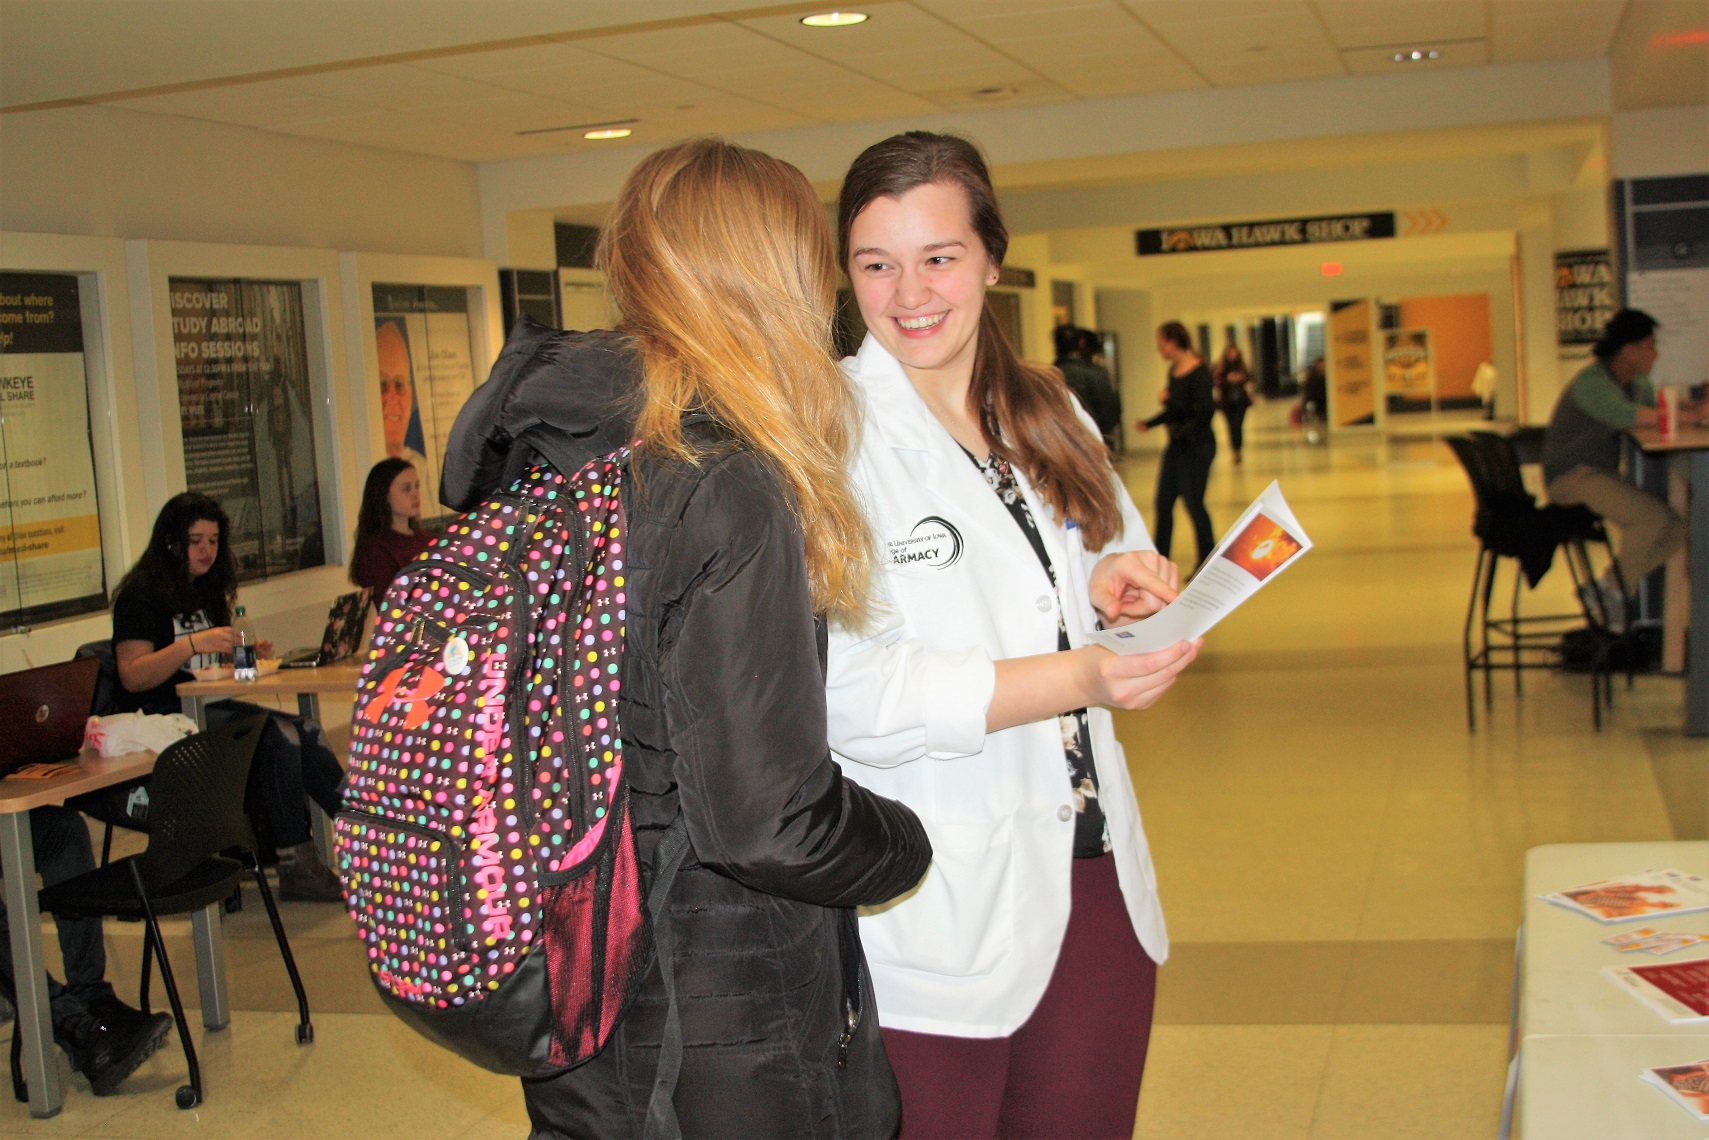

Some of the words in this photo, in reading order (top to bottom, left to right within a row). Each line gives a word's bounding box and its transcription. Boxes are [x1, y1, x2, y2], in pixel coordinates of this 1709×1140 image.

[1161, 228, 1227, 250] IWA
[1231, 223, 1304, 246] HAWK
[1306, 218, 1371, 240] SHOP
[23, 292, 54, 307] where
[25, 310, 54, 324] from?
[173, 316, 208, 334] TUDY
[210, 316, 261, 334] ABROAD
[201, 340, 260, 359] SESSIONS
[7, 390, 35, 401] SHARE
[47, 492, 65, 503] afford
[66, 489, 87, 501] more?
[933, 532, 947, 540] IOWA
[893, 548, 939, 564] ARMACY
[480, 652, 507, 779] UNDER
[477, 788, 513, 940] ARMOUR
